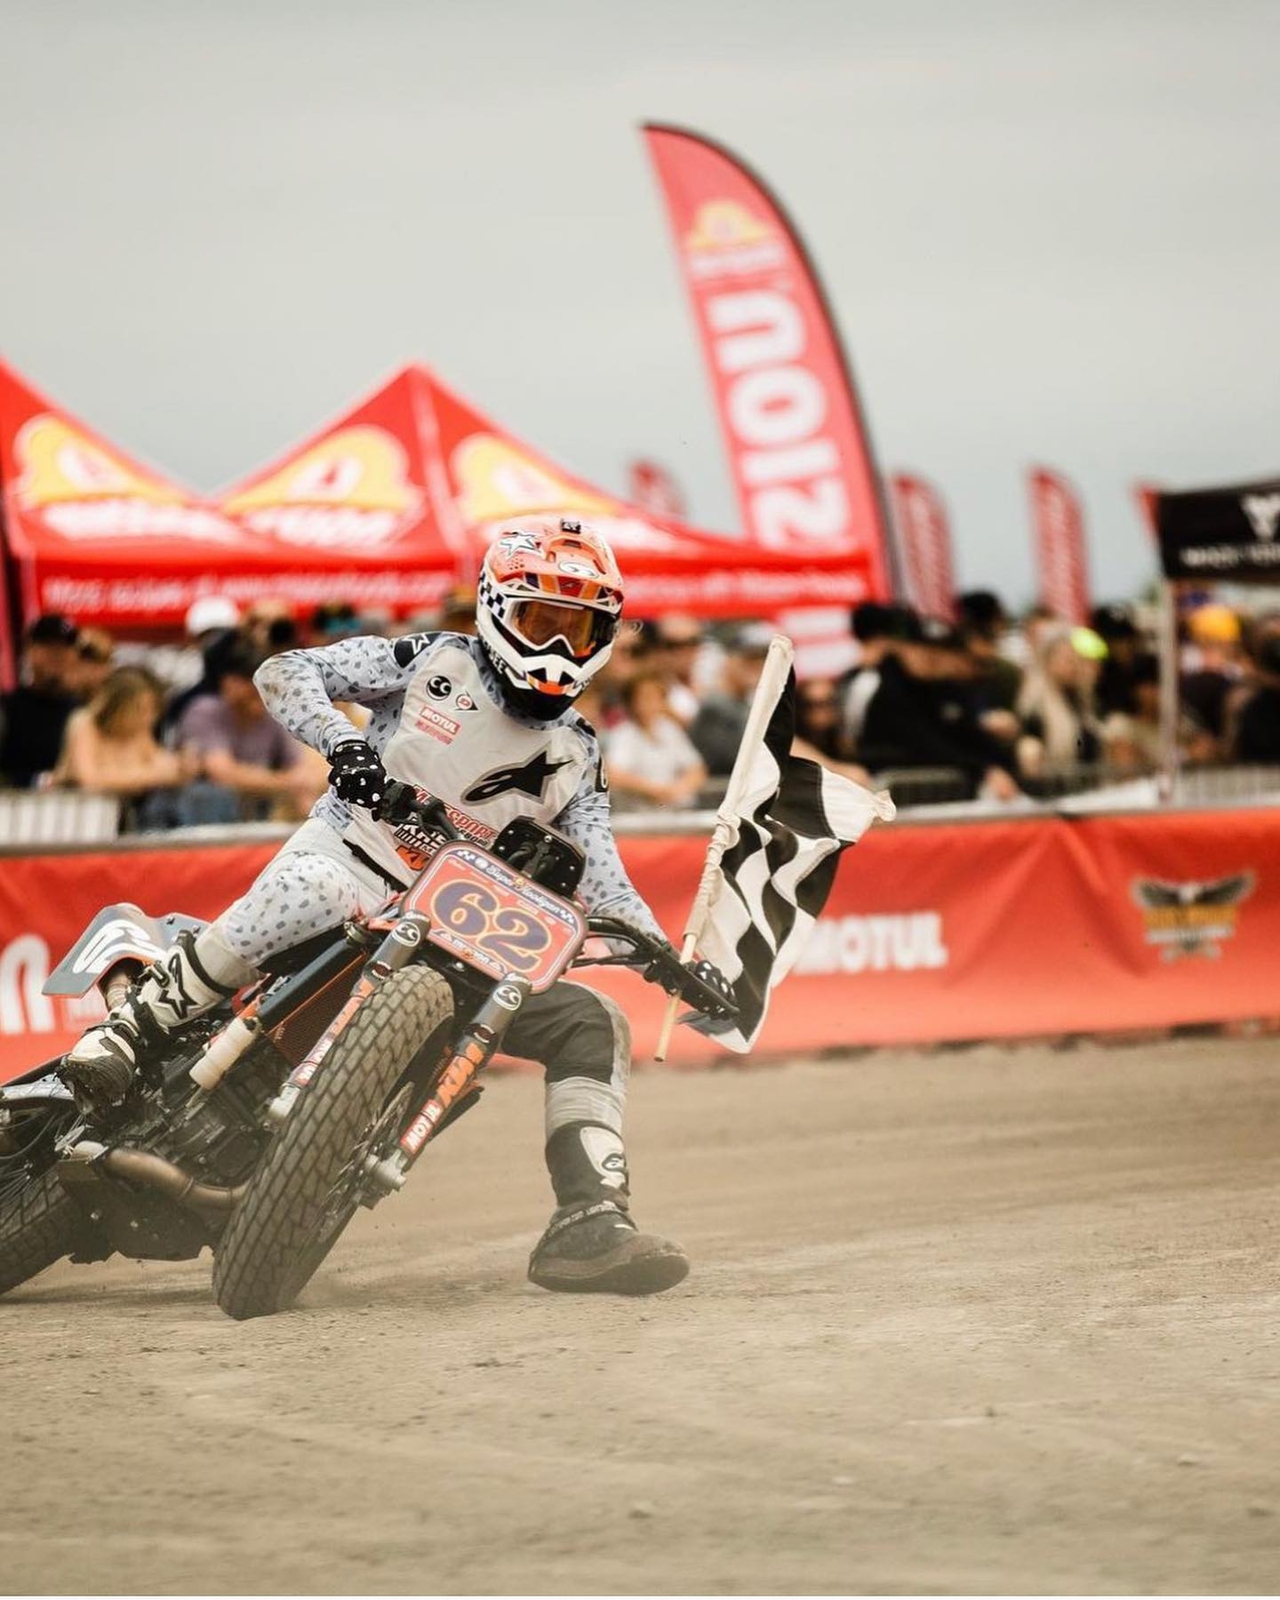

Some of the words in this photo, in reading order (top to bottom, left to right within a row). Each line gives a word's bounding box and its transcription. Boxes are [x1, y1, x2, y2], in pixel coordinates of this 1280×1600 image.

[420, 708, 459, 734] MOTUL
[431, 879, 552, 972] 62
[792, 911, 948, 976] MOTUL
[404, 1104, 442, 1150] MOTUL
